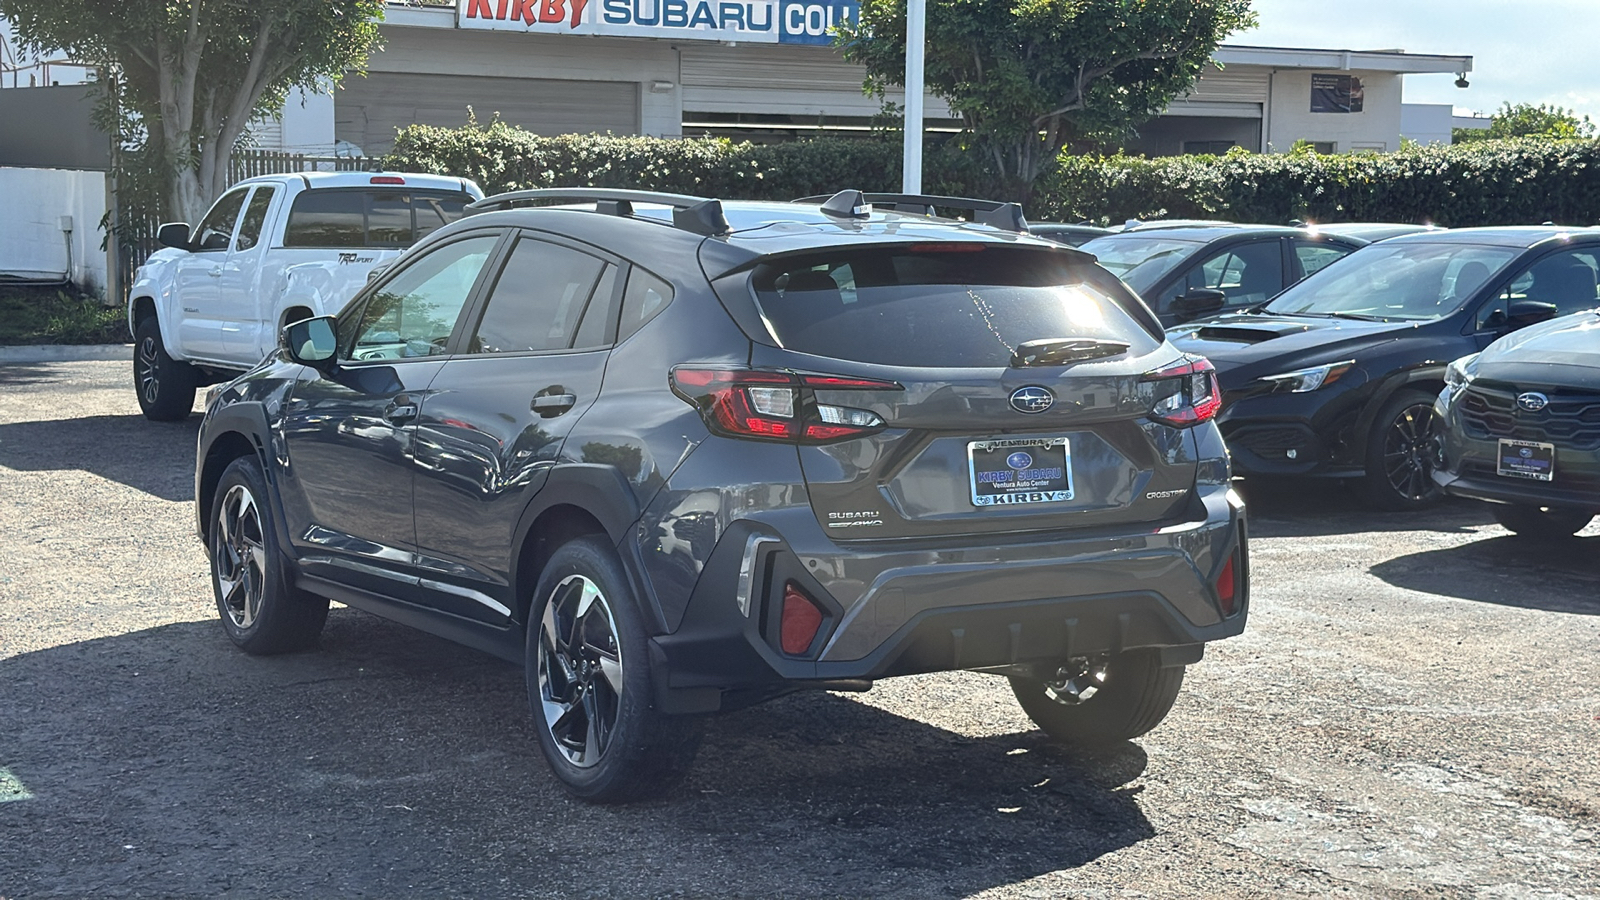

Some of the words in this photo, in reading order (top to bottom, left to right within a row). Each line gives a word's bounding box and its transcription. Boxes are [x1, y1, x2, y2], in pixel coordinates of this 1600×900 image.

[466, 0, 588, 29] KIRBY
[603, 0, 772, 31] SUBARU
[993, 439, 1044, 447] VENTURA
[978, 470, 1013, 483] KIRBY
[1018, 468, 1061, 480] SUBARU
[993, 492, 1055, 504] KIRBY
[828, 511, 879, 519] SUBARU
